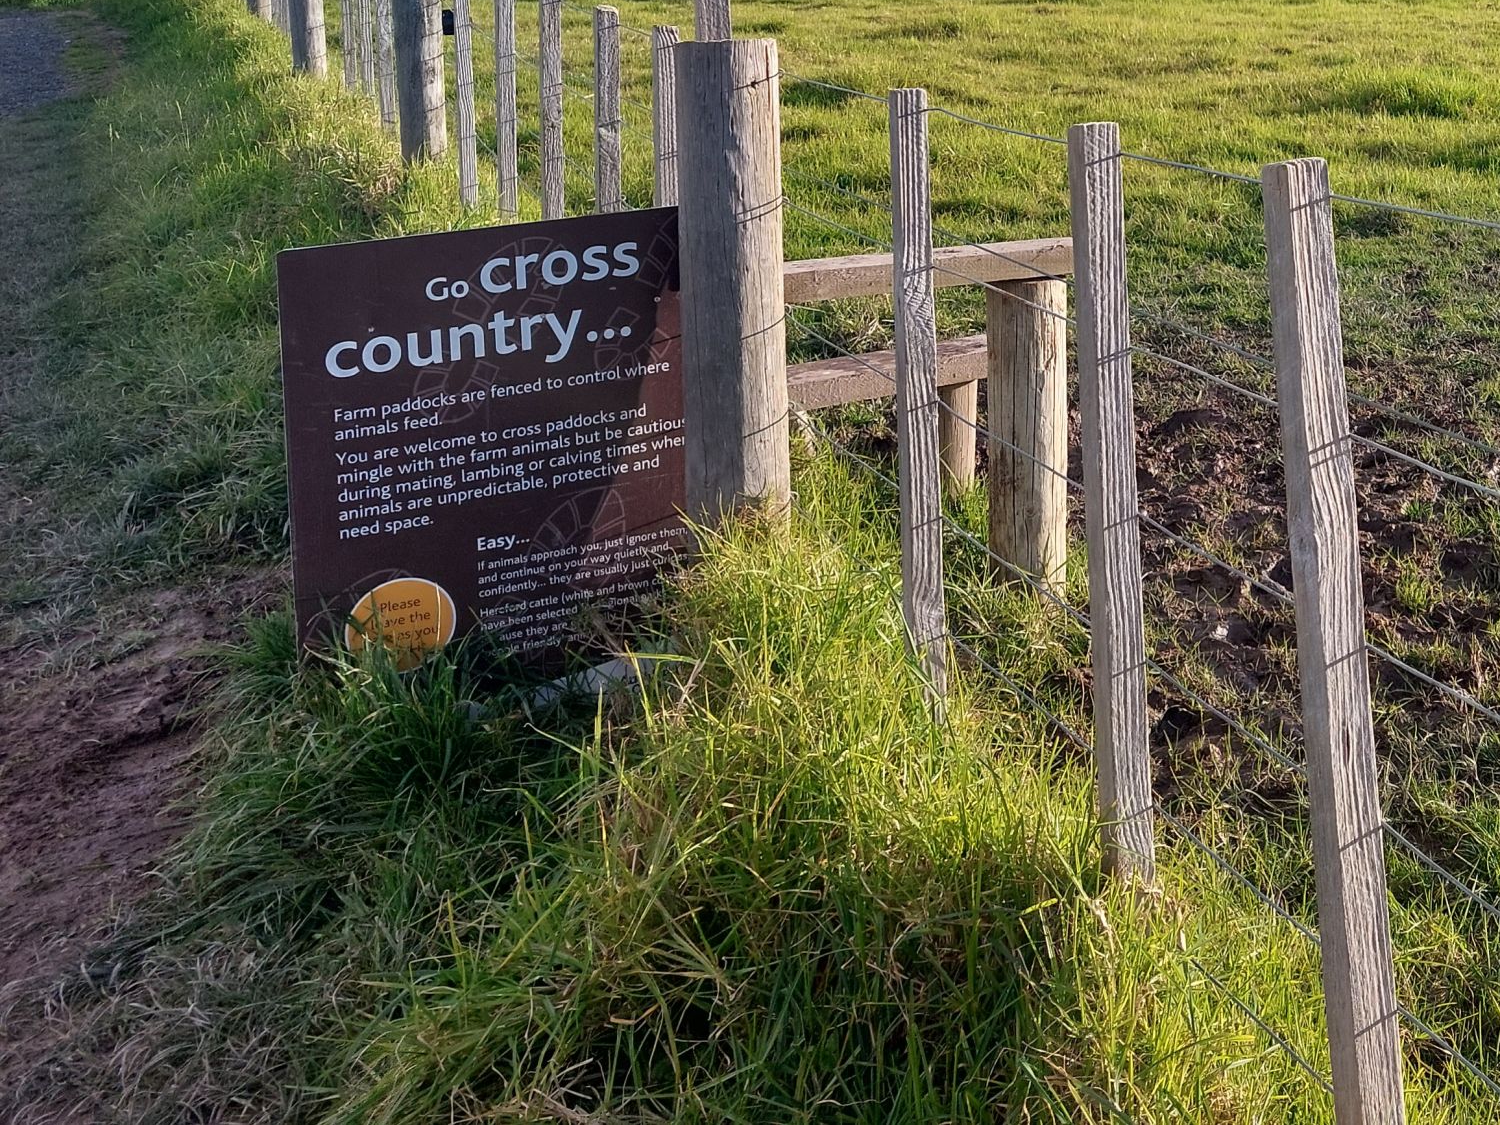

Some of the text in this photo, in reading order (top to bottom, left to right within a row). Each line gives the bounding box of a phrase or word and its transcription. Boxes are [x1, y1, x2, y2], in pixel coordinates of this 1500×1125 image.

[425, 241, 640, 301] Go cross
[325, 309, 632, 378] country...
[334, 361, 670, 423] Farm paddocks are fenced to control where
[334, 412, 443, 441] animals feed.
[335, 403, 647, 466] You are welcome to cross paddocks and
[337, 464, 393, 485] mingle
[398, 457, 434, 475] with
[439, 453, 466, 468] the
[470, 447, 507, 463] farm
[512, 436, 571, 457] animals
[575, 431, 601, 446] but
[604, 426, 623, 441] be
[338, 485, 391, 503] during
[396, 474, 456, 494] mating,
[461, 461, 524, 483] lambing
[528, 458, 545, 471] or
[549, 449, 602, 467] calving
[605, 442, 648, 458] times
[338, 454, 660, 522] animals are unpredictable, protective and
[339, 515, 434, 540] need space.
[477, 534, 530, 551] Easy...
[477, 560, 485, 571] If
[487, 554, 528, 570] animals
[530, 544, 578, 563] approach
[580, 542, 602, 555] you,
[604, 538, 624, 551] just
[626, 532, 657, 546] ignore
[478, 541, 670, 584] and continue on your way quietly and
[478, 577, 546, 598] confidently...
[549, 574, 572, 586] they
[575, 571, 591, 581] are
[593, 562, 629, 576] usually
[631, 559, 650, 572] just
[529, 595, 559, 608] cattle
[561, 588, 594, 604] (white
[596, 584, 615, 596] and
[617, 580, 649, 592] brown
[380, 598, 421, 613] Please
[409, 611, 431, 624] the
[508, 615, 533, 626] been
[535, 605, 578, 620] selected
[414, 626, 438, 642] you
[525, 625, 549, 637] they
[551, 621, 568, 632] are
